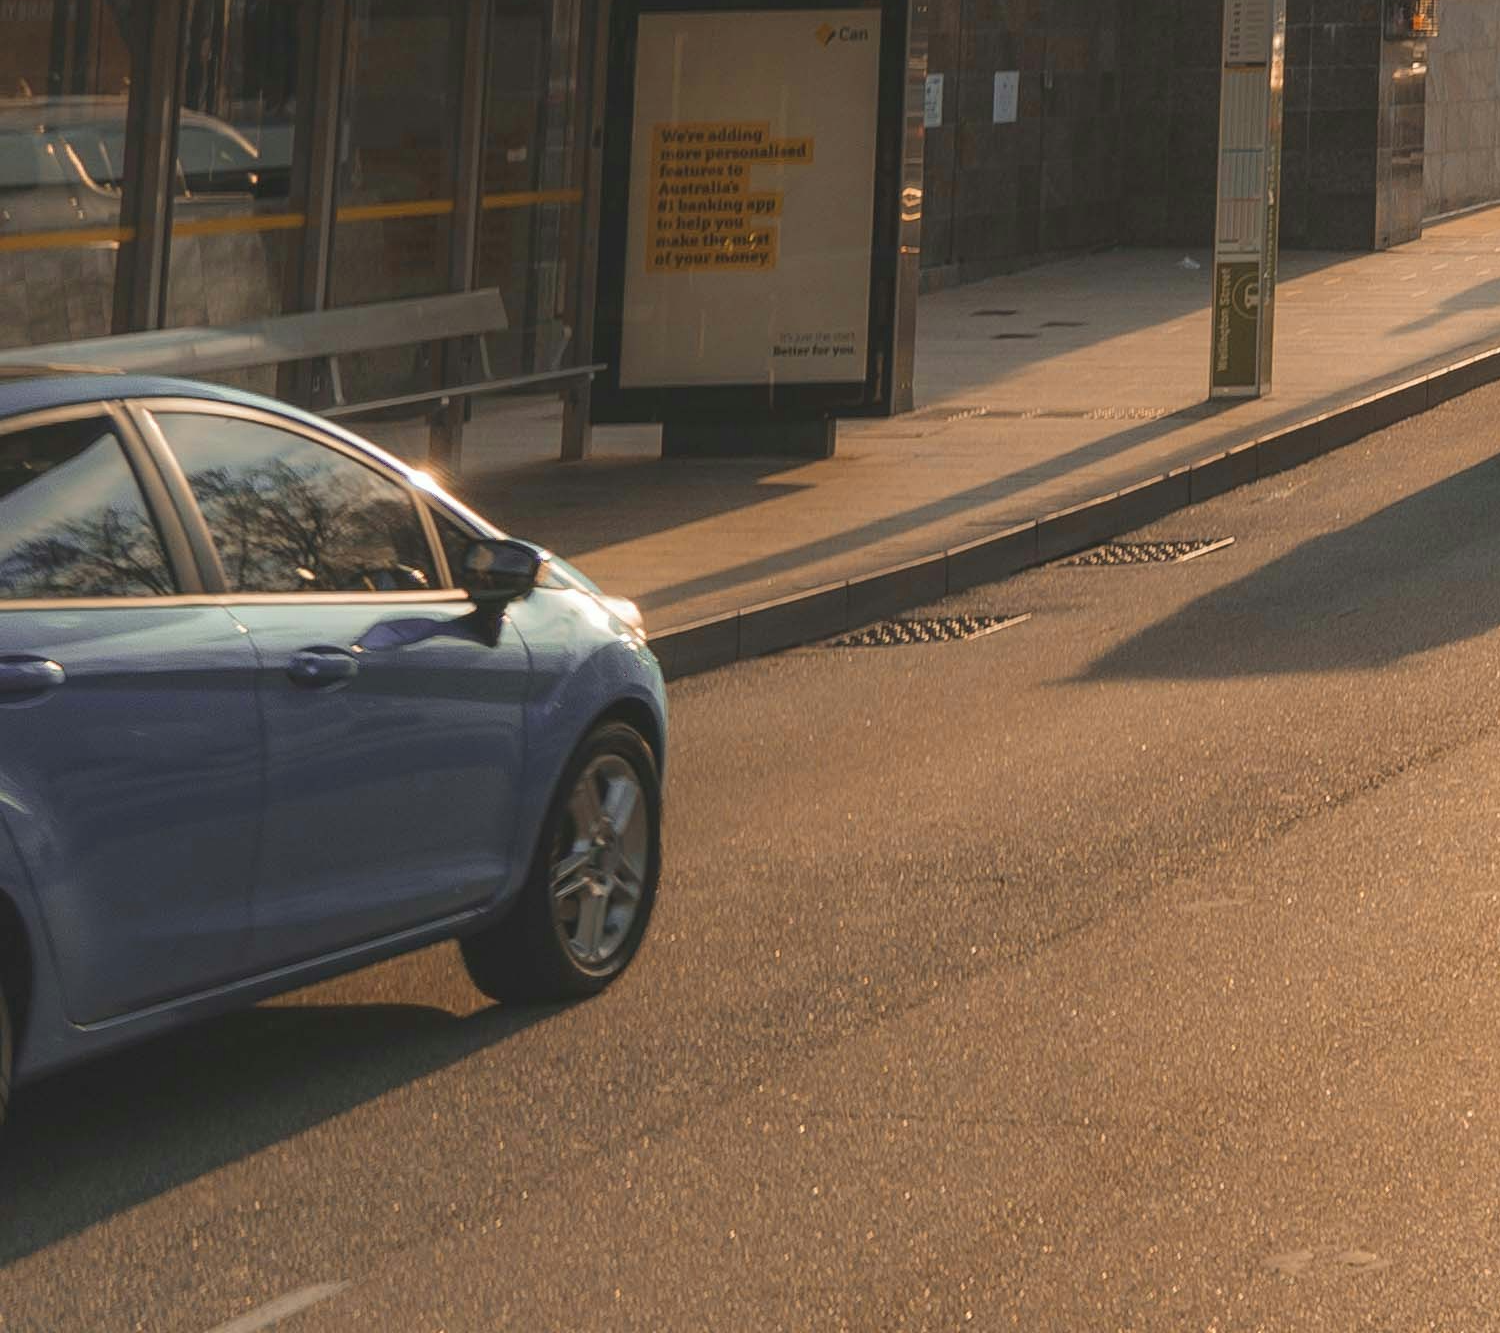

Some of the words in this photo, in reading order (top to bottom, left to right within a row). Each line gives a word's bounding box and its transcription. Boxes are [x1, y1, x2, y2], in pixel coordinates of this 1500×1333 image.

[839, 26, 869, 43] Can
[661, 129, 705, 143] We're
[708, 129, 762, 145] adding
[660, 148, 702, 161] more
[705, 143, 807, 164] personalised
[659, 164, 723, 179] features
[727, 165, 743, 177] to
[659, 180, 739, 195] Australia's
[657, 198, 674, 213] #1
[678, 197, 744, 215] banking
[746, 199, 775, 215] app
[656, 217, 673, 231] to
[676, 216, 712, 233] help
[714, 219, 744, 233] you
[655, 234, 699, 248] make
[703, 233, 728, 247] the
[655, 251, 673, 266] of
[675, 252, 711, 268] your
[1218, 267, 1233, 306] Street
[773, 343, 808, 357] Better
[811, 343, 829, 356] for
